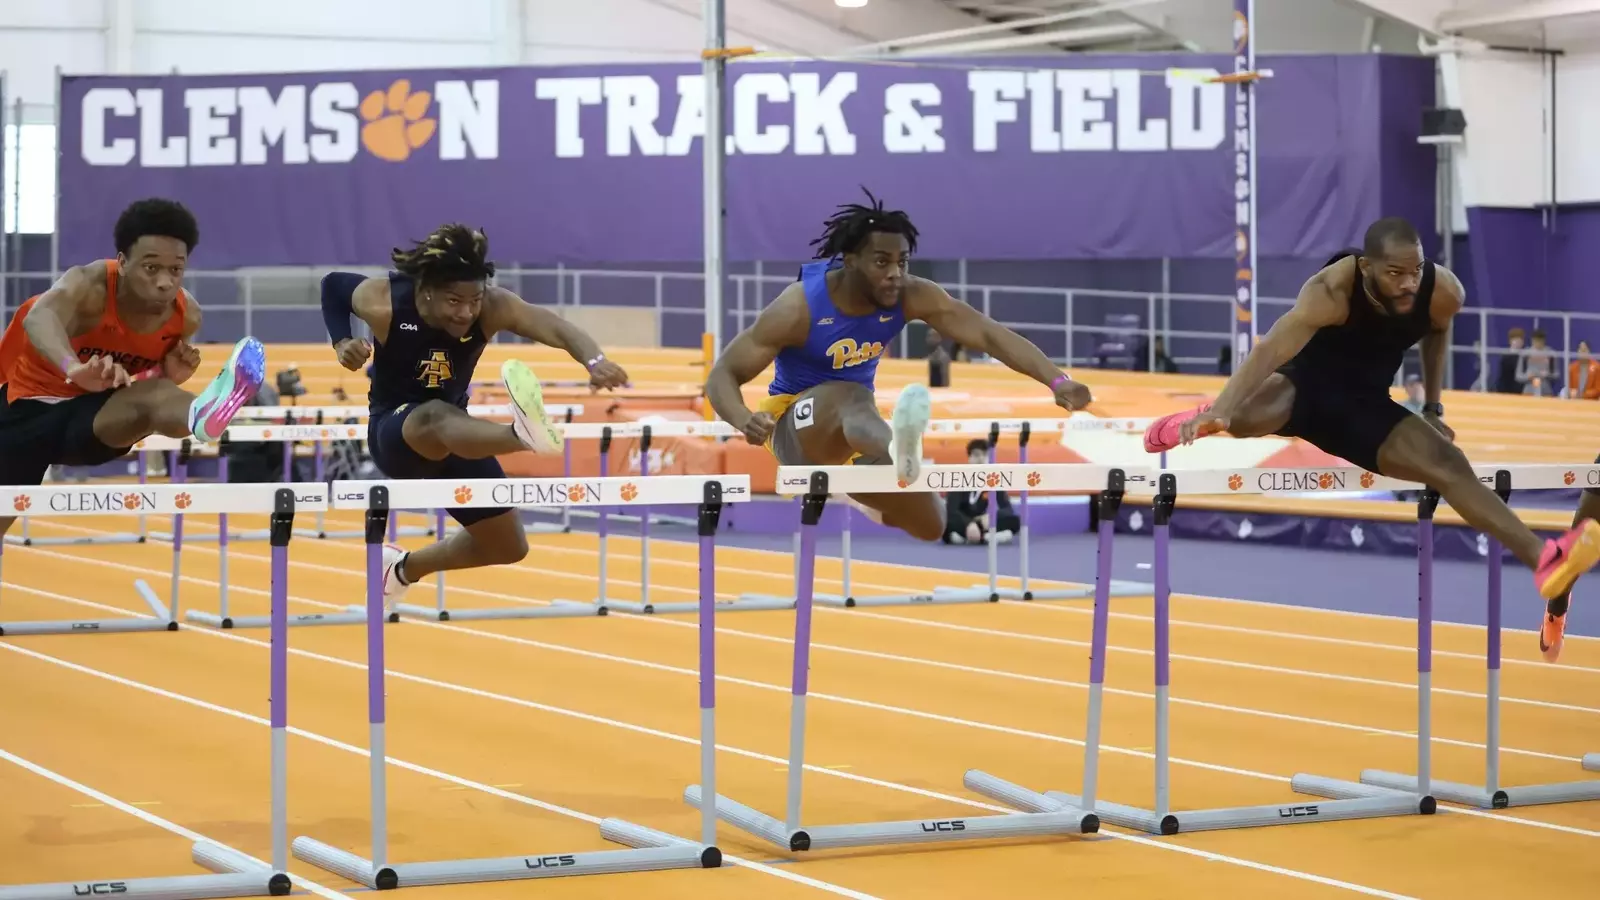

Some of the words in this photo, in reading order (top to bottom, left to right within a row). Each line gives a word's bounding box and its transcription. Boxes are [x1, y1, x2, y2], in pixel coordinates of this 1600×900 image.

[536, 72, 858, 157] TRACK
[883, 83, 945, 153] &
[968, 69, 1226, 152] FIELD
[399, 322, 418, 331] CAA
[826, 338, 884, 370] Pitt
[1279, 805, 1319, 818] UCS
[921, 820, 966, 832] UCS
[525, 855, 576, 869] UCS
[73, 881, 127, 896] UCS
